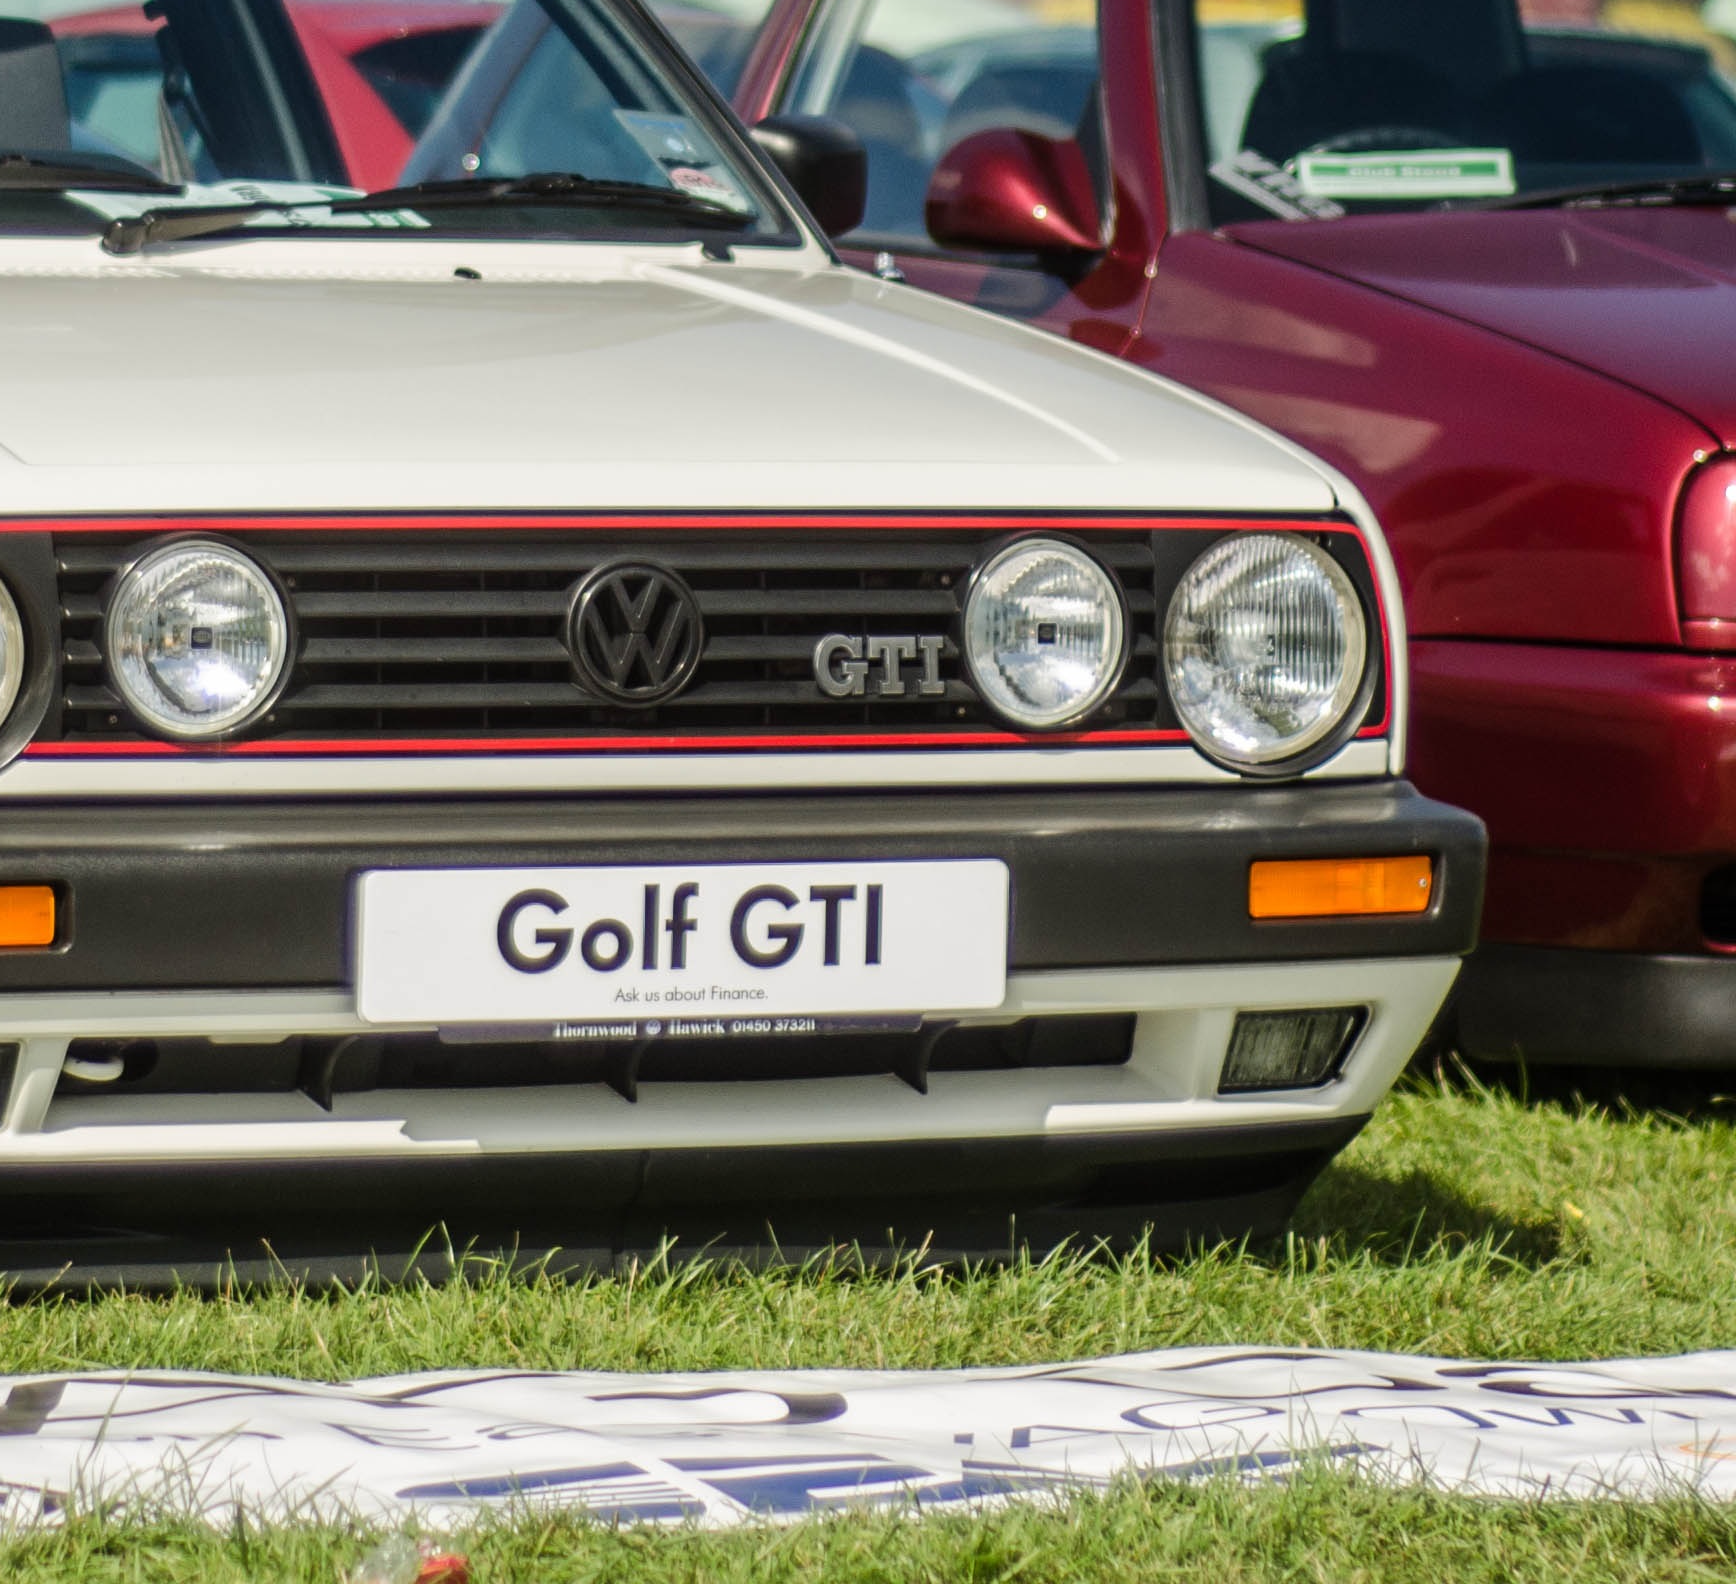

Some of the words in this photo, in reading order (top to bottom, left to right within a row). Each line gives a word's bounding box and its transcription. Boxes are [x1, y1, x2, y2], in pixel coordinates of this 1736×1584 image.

[574, 564, 696, 698] VW
[813, 633, 948, 697] GTI
[496, 881, 700, 974] Golf
[729, 883, 884, 970] GTI
[614, 987, 640, 1003] Ask
[645, 991, 660, 1002] us
[664, 987, 707, 1002] about
[711, 985, 769, 1000] Finance.
[732, 1020, 771, 1033] 01450
